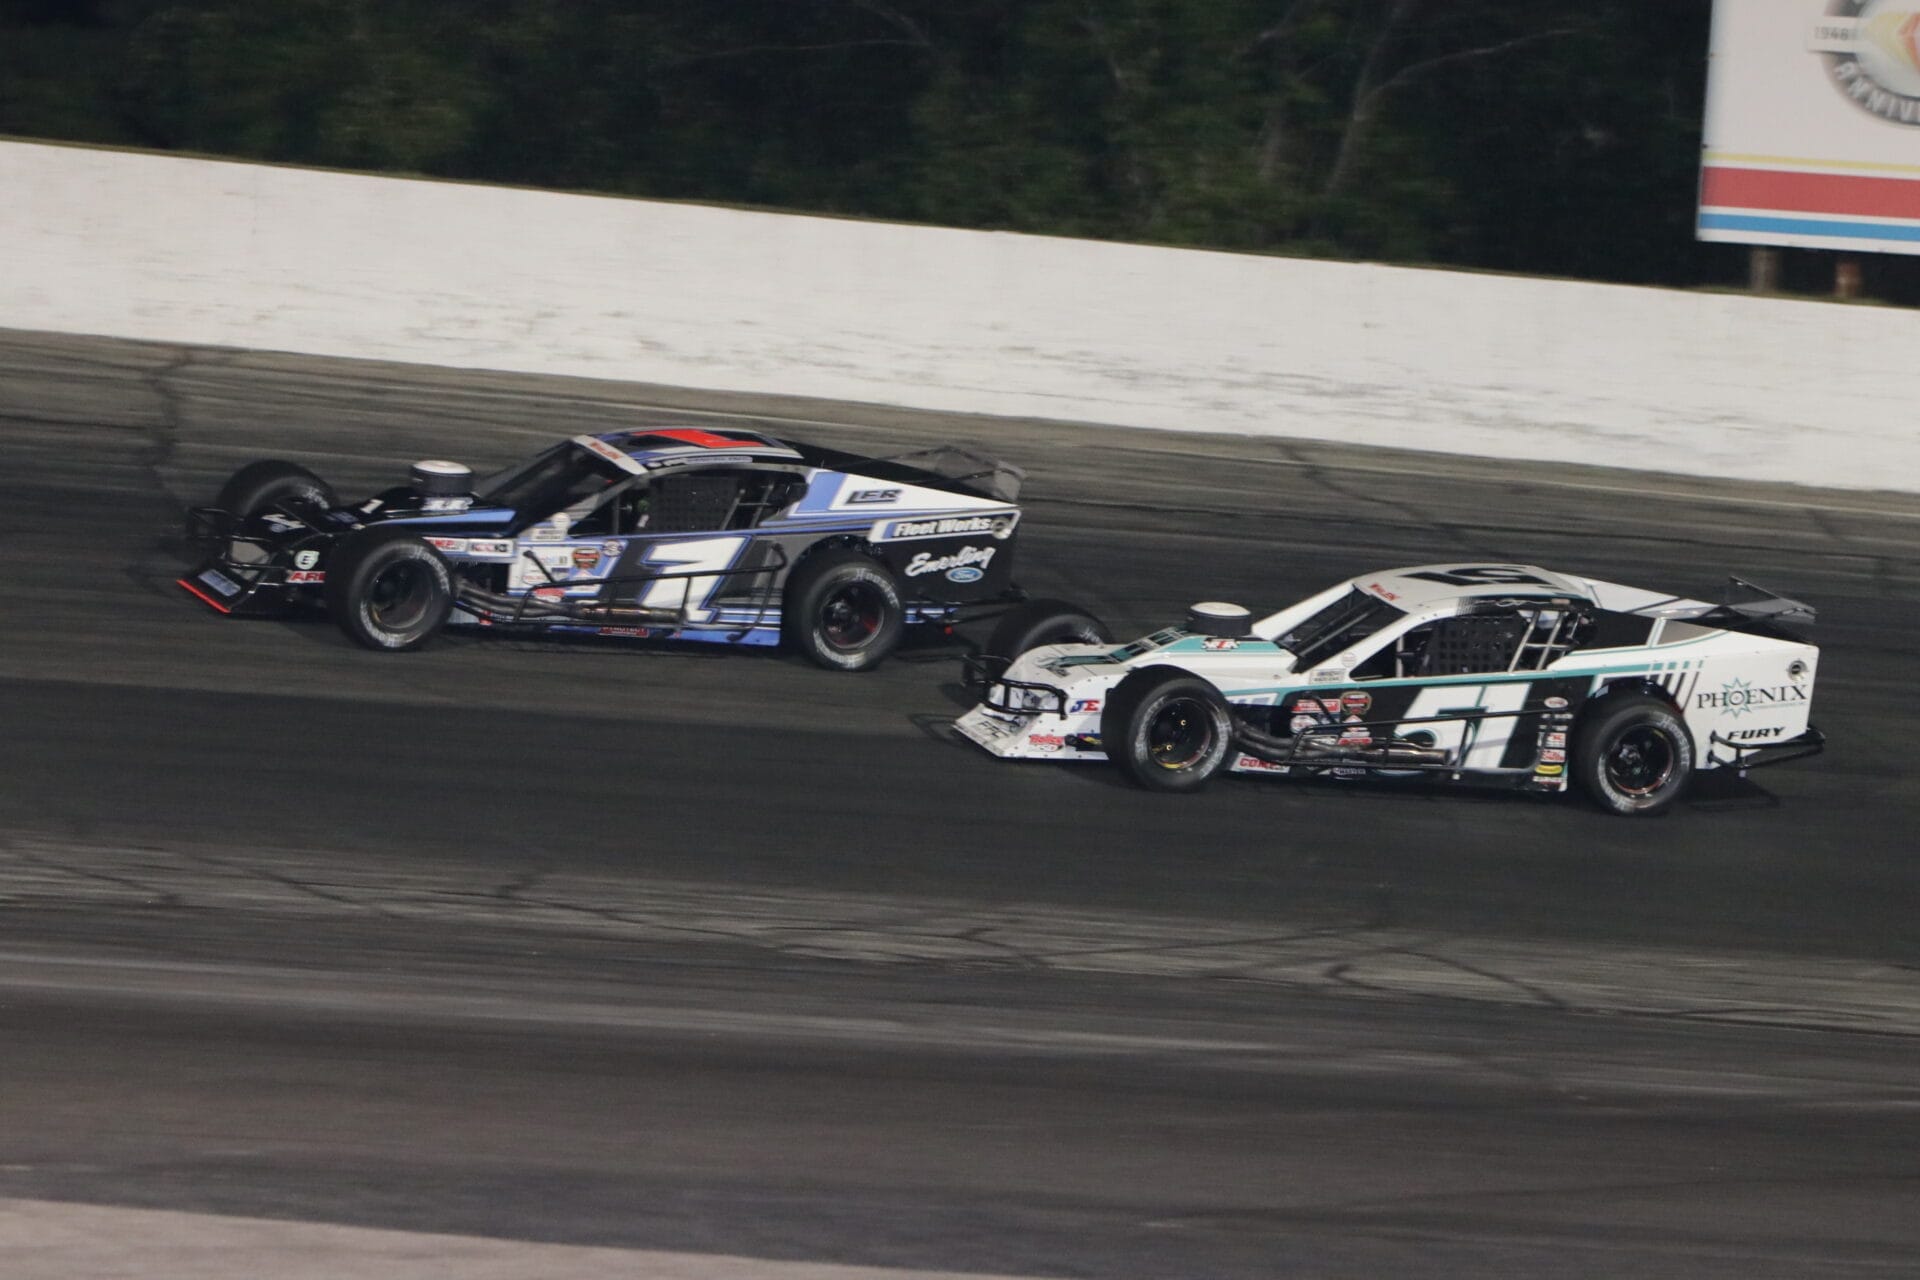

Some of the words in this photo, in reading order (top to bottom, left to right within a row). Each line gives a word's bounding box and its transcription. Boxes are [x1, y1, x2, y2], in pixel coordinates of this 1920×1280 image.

[892, 520, 936, 539] Fleet
[936, 516, 994, 535] Works
[1696, 684, 1808, 709] PHOENIX
[1726, 726, 1788, 741] FURY
